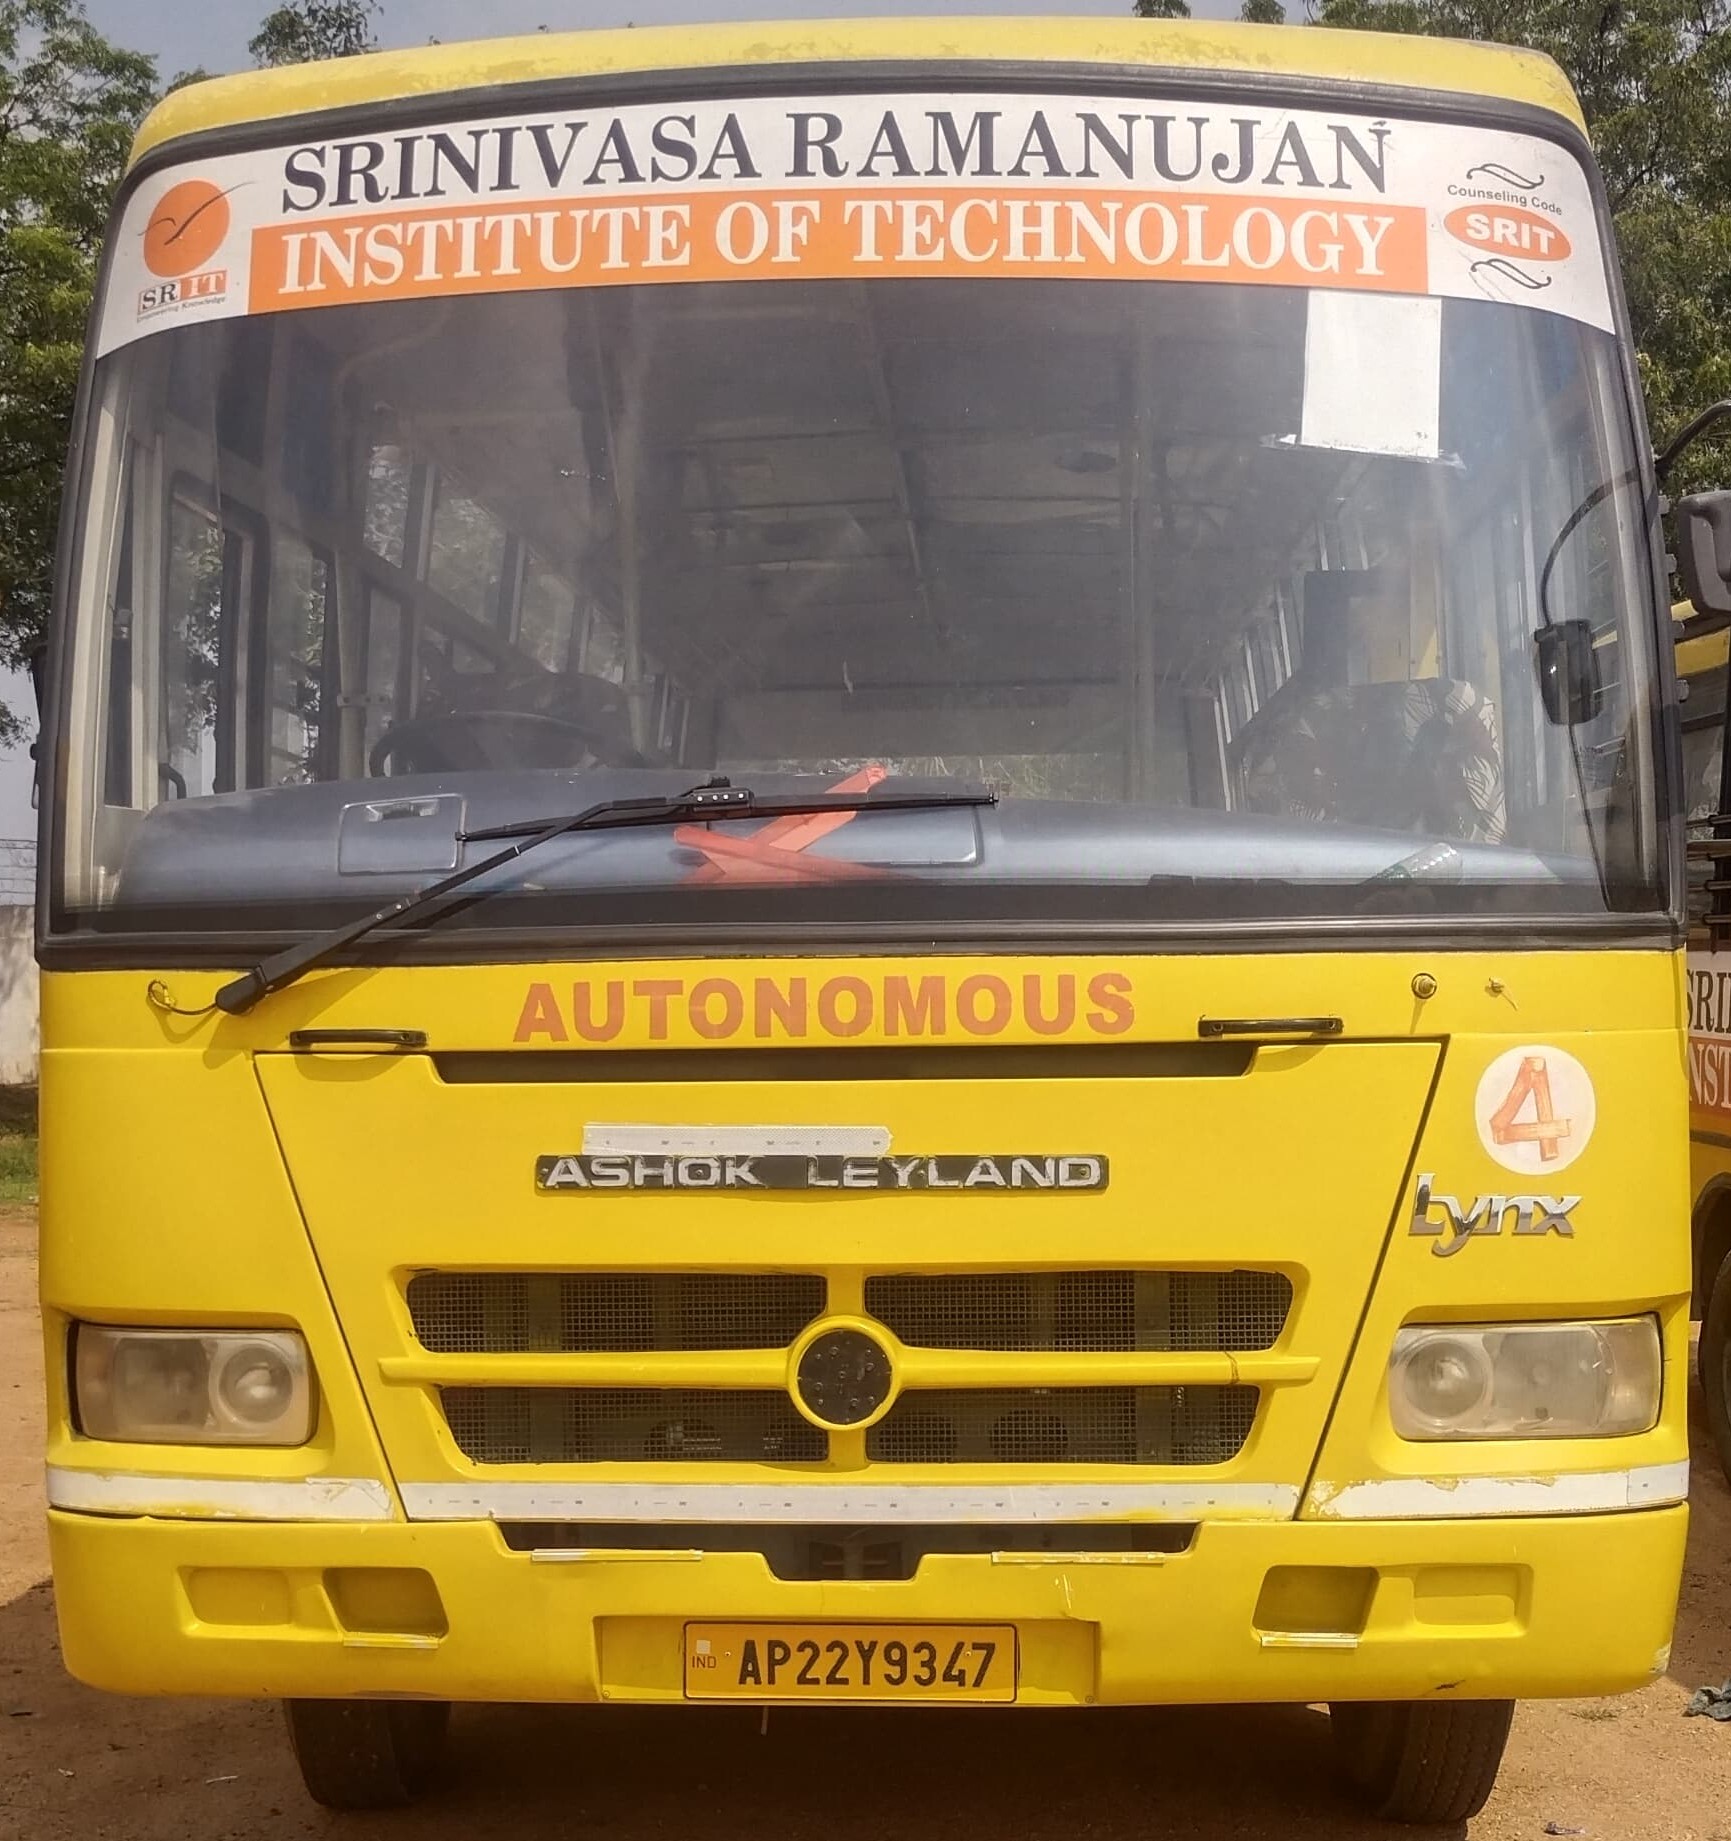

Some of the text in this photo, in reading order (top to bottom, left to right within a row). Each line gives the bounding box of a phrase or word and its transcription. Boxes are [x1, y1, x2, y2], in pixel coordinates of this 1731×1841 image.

[282, 110, 1390, 214] SRINIVASA RAMANUJAN
[1447, 184, 1562, 216] Counseling Code
[1466, 213, 1555, 255] SRIT
[277, 198, 1394, 294] INSTITUTE OF TECHNOLOGY
[513, 973, 1135, 1043] AUTONOMOUS
[1489, 1056, 1572, 1162] 4
[544, 1155, 1102, 1189] ASHOK LEYLAND
[1408, 1173, 1583, 1257] Lynx
[692, 1639, 996, 1688] IND AP22Y9347
